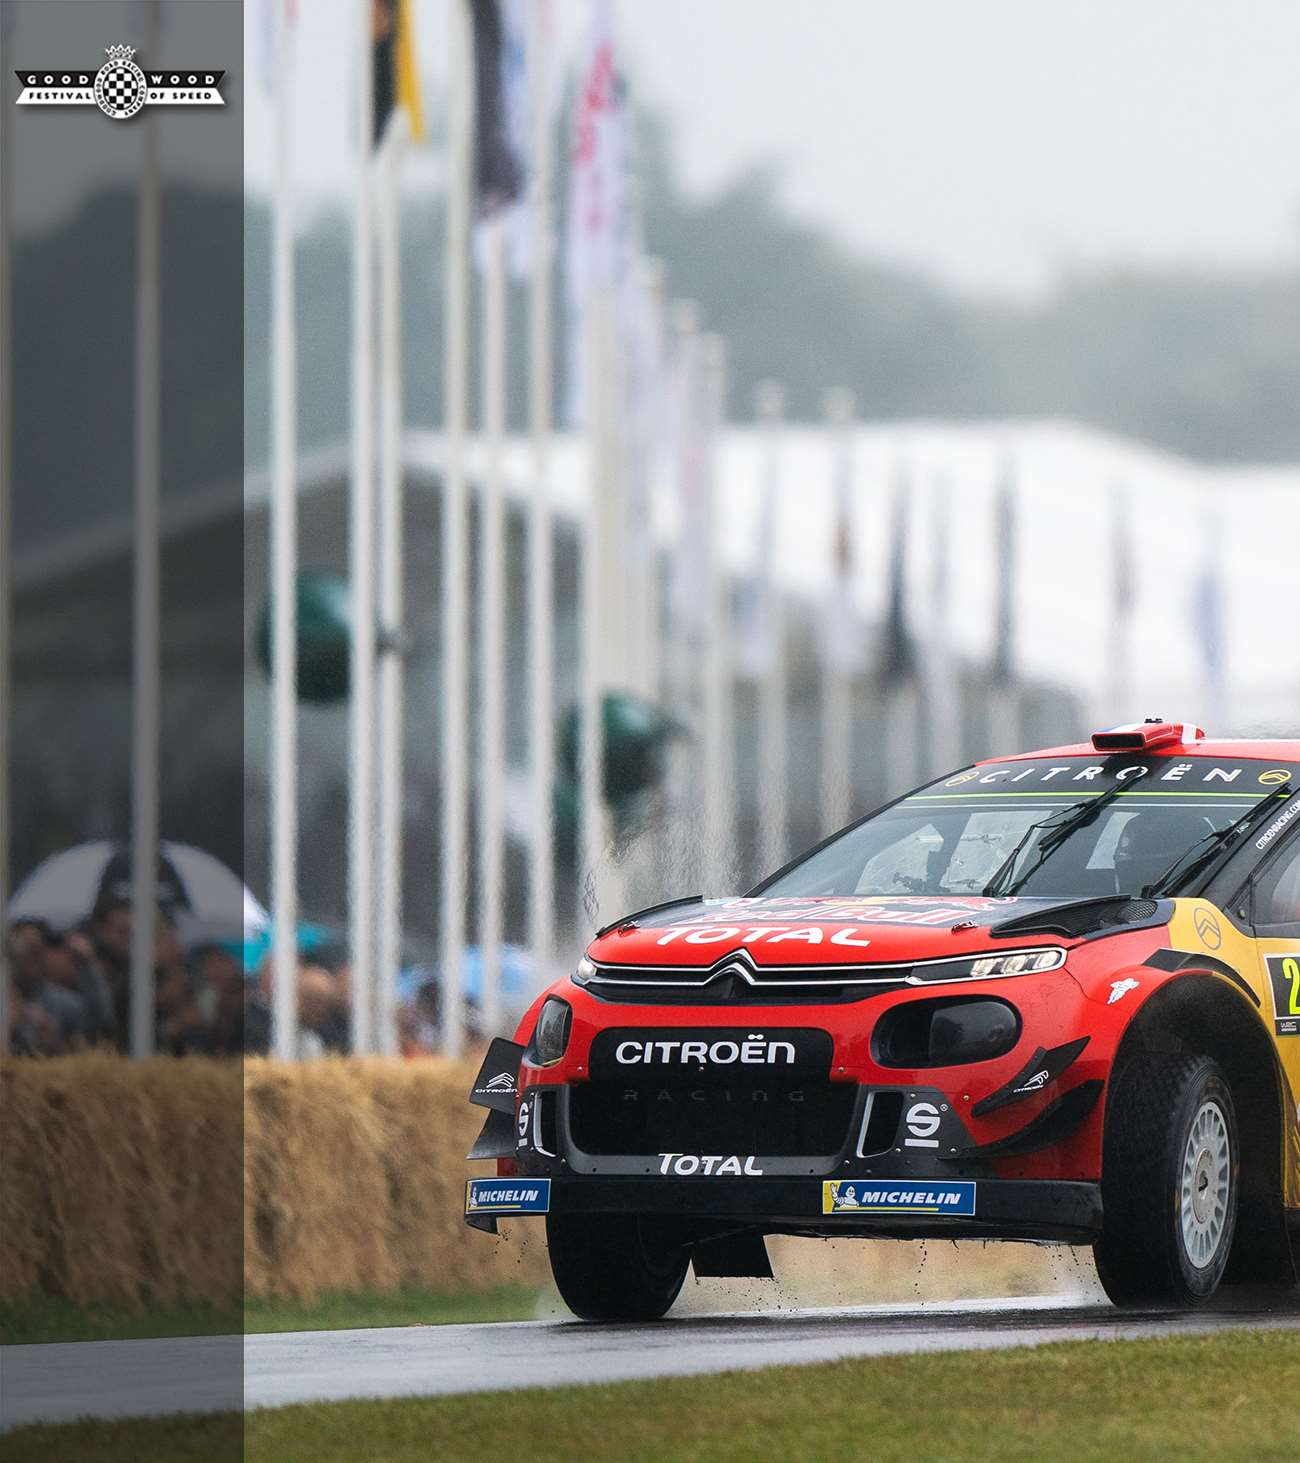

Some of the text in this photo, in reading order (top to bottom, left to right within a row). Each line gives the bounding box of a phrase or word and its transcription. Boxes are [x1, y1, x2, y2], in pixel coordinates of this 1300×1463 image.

[656, 925, 872, 947] TOTAL
[657, 1153, 764, 1176] TOTAL
[478, 1190, 539, 1203] MICHELIN
[861, 1190, 961, 1206] MICHELIN
